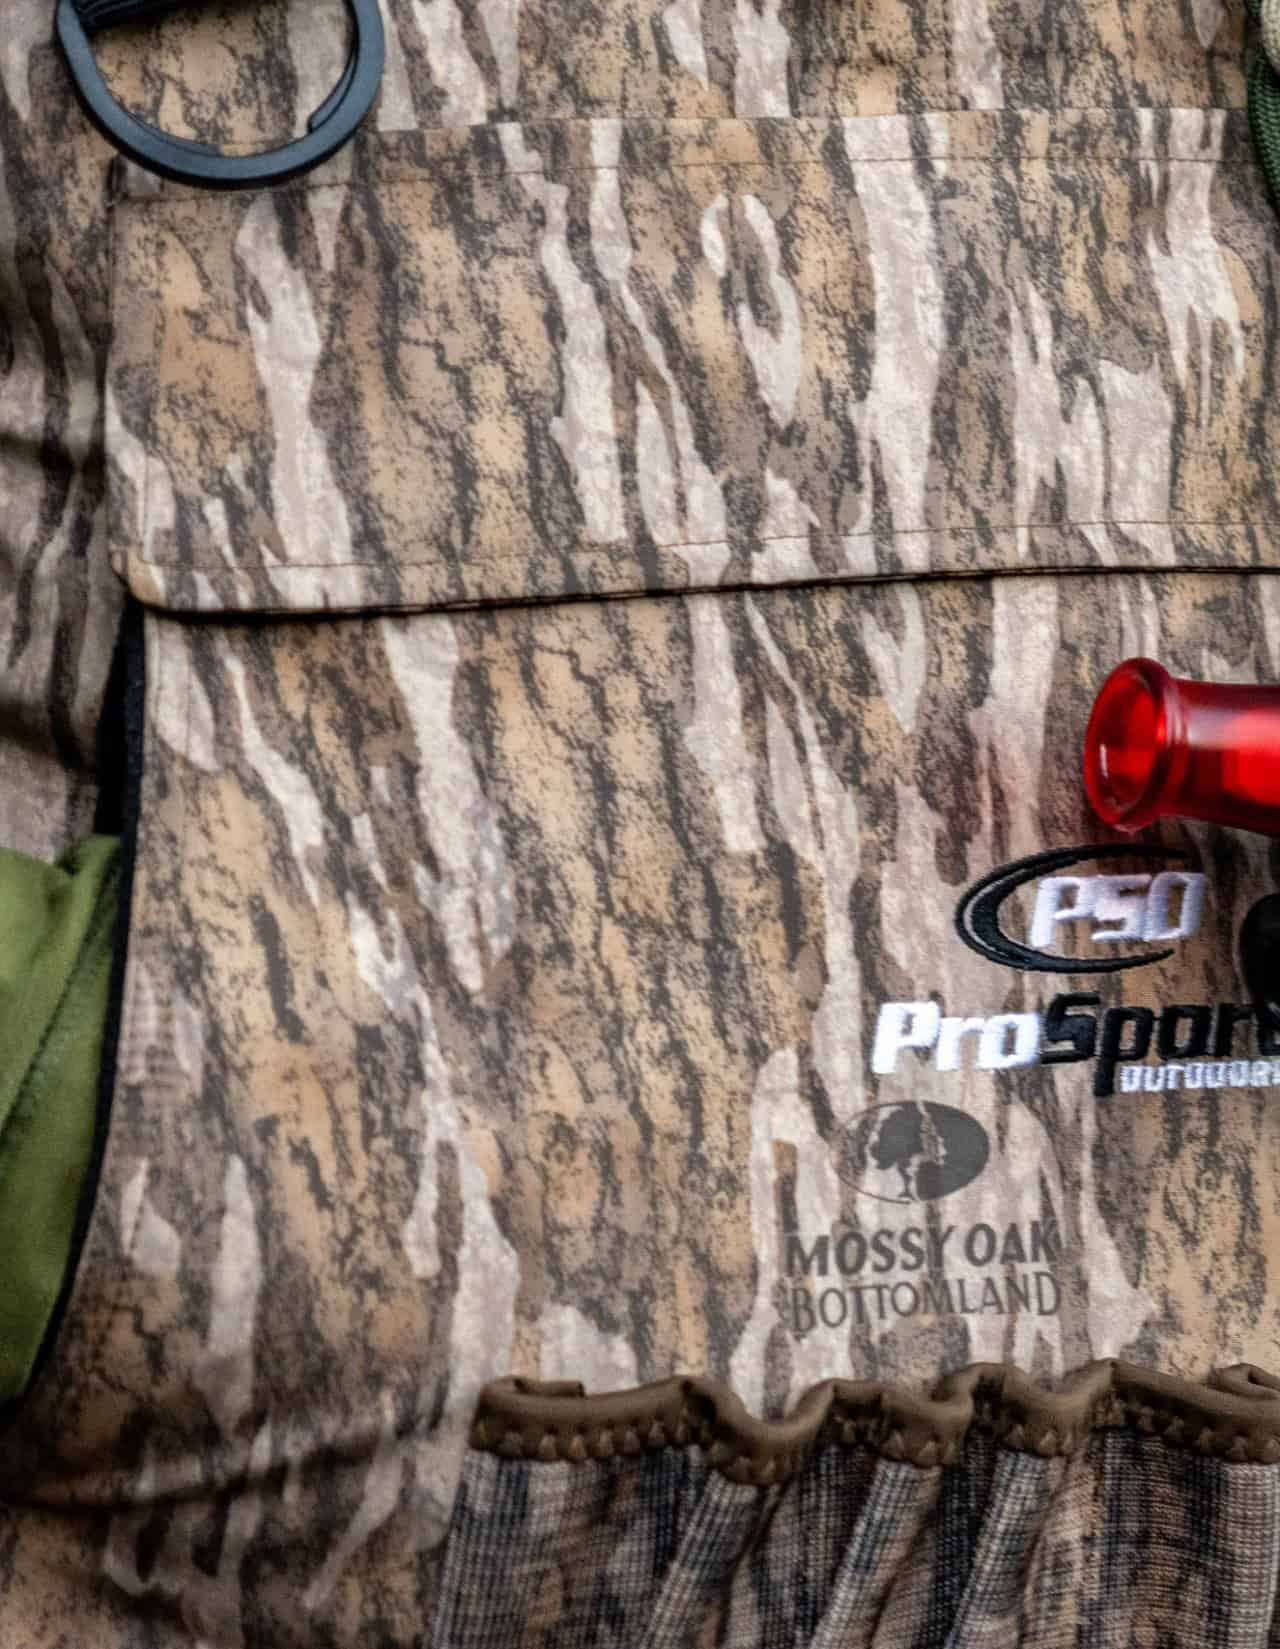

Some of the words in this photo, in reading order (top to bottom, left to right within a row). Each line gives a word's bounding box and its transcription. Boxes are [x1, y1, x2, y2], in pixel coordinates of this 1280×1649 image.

[1030, 872, 1208, 948] PSO
[784, 1225, 956, 1277] MOSSY
[964, 1221, 1061, 1267] OAK
[791, 1271, 1061, 1338] BOTTOMLAND
